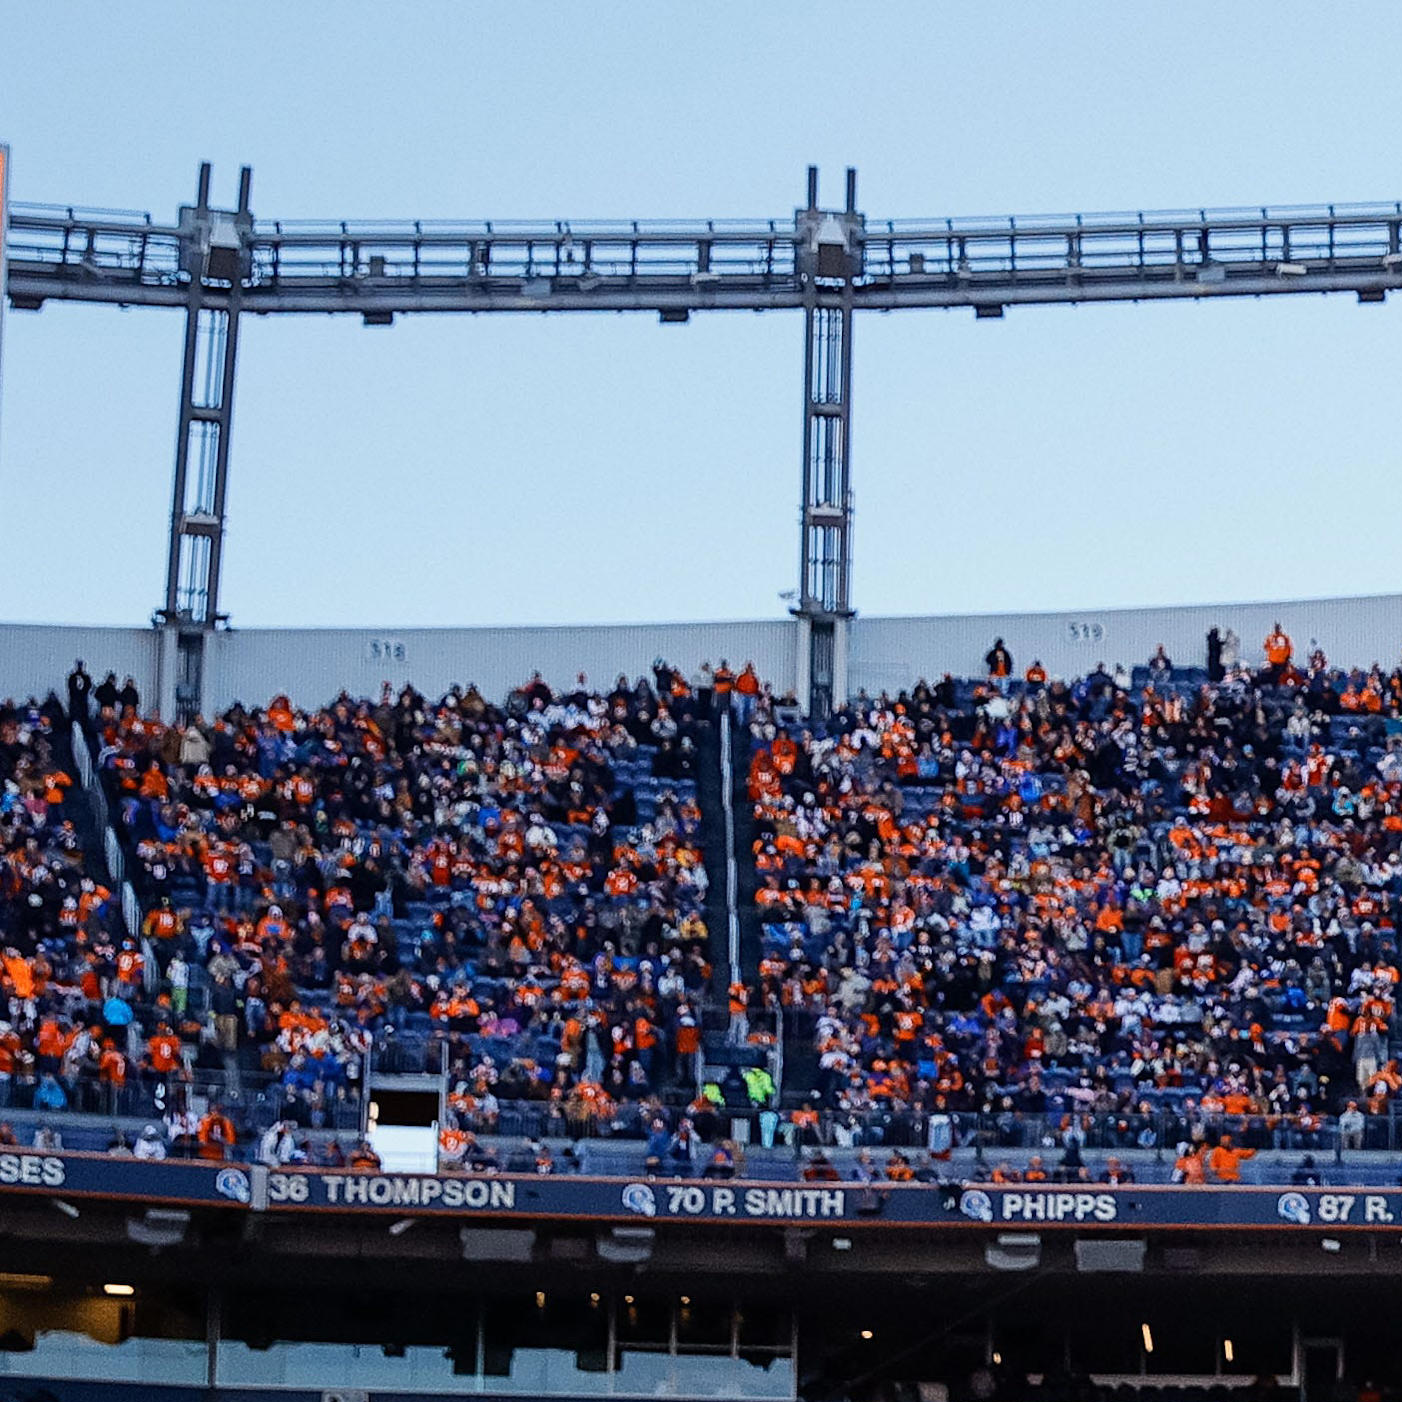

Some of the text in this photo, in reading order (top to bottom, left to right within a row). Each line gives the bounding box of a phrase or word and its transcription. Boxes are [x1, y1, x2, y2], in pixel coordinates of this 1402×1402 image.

[268, 1173, 516, 1211] 36 THOMPSON
[667, 1186, 845, 1218] 70 P. SMITH
[1002, 1193, 1117, 1222] PHIPPS
[1318, 1195, 1357, 1222] 87
[1363, 1195, 1394, 1223] R.
